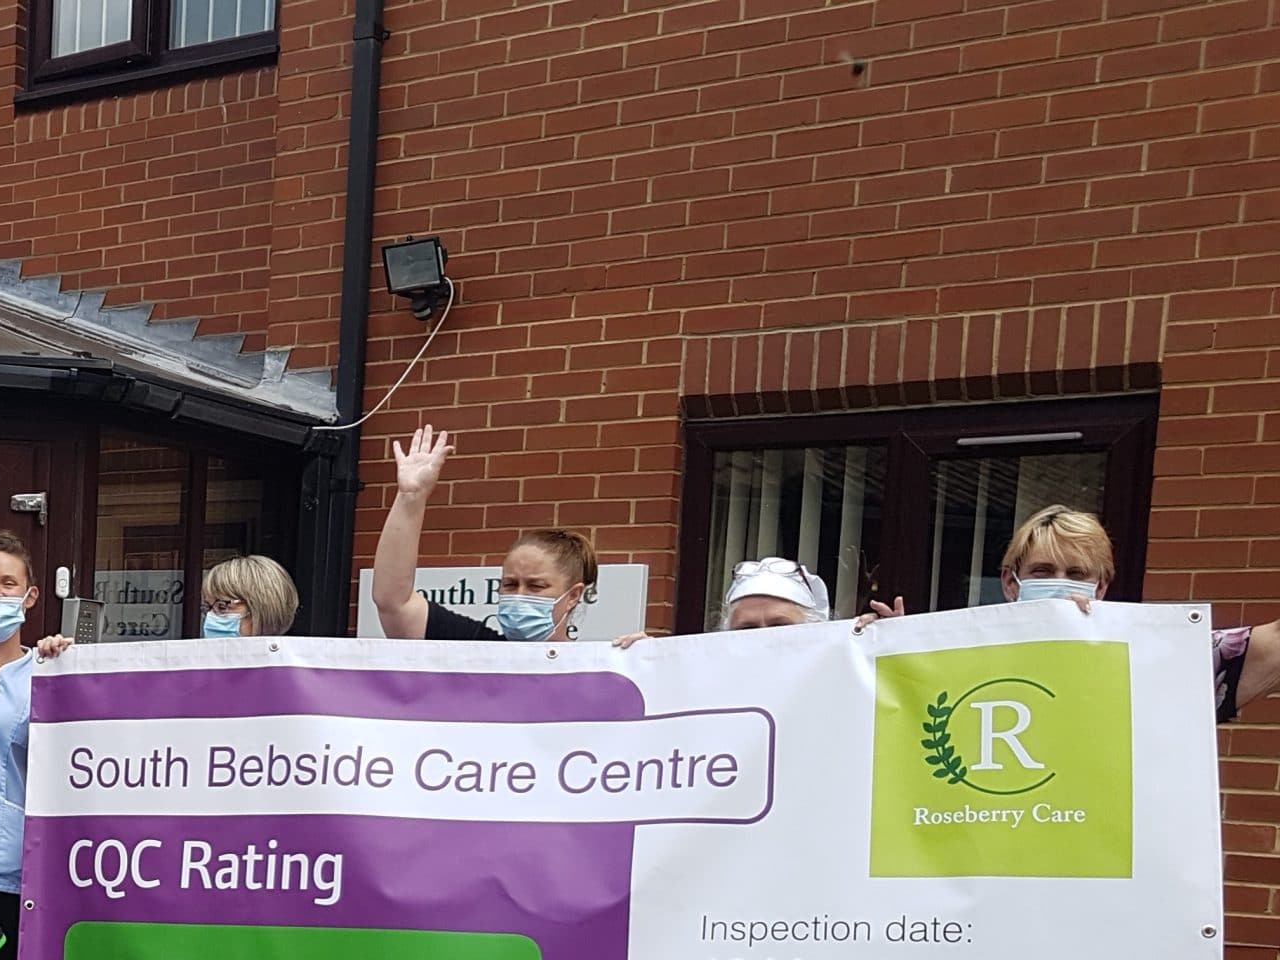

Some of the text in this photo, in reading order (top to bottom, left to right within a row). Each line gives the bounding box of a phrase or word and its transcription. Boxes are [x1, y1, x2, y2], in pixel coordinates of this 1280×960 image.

[416, 579, 475, 605] outh
[971, 700, 1045, 771] R
[69, 743, 738, 794] South Bebside Care Centre
[914, 803, 1086, 829] Roseberry Care
[68, 839, 344, 905] CQC Rating
[702, 915, 974, 946] Inspection date:
